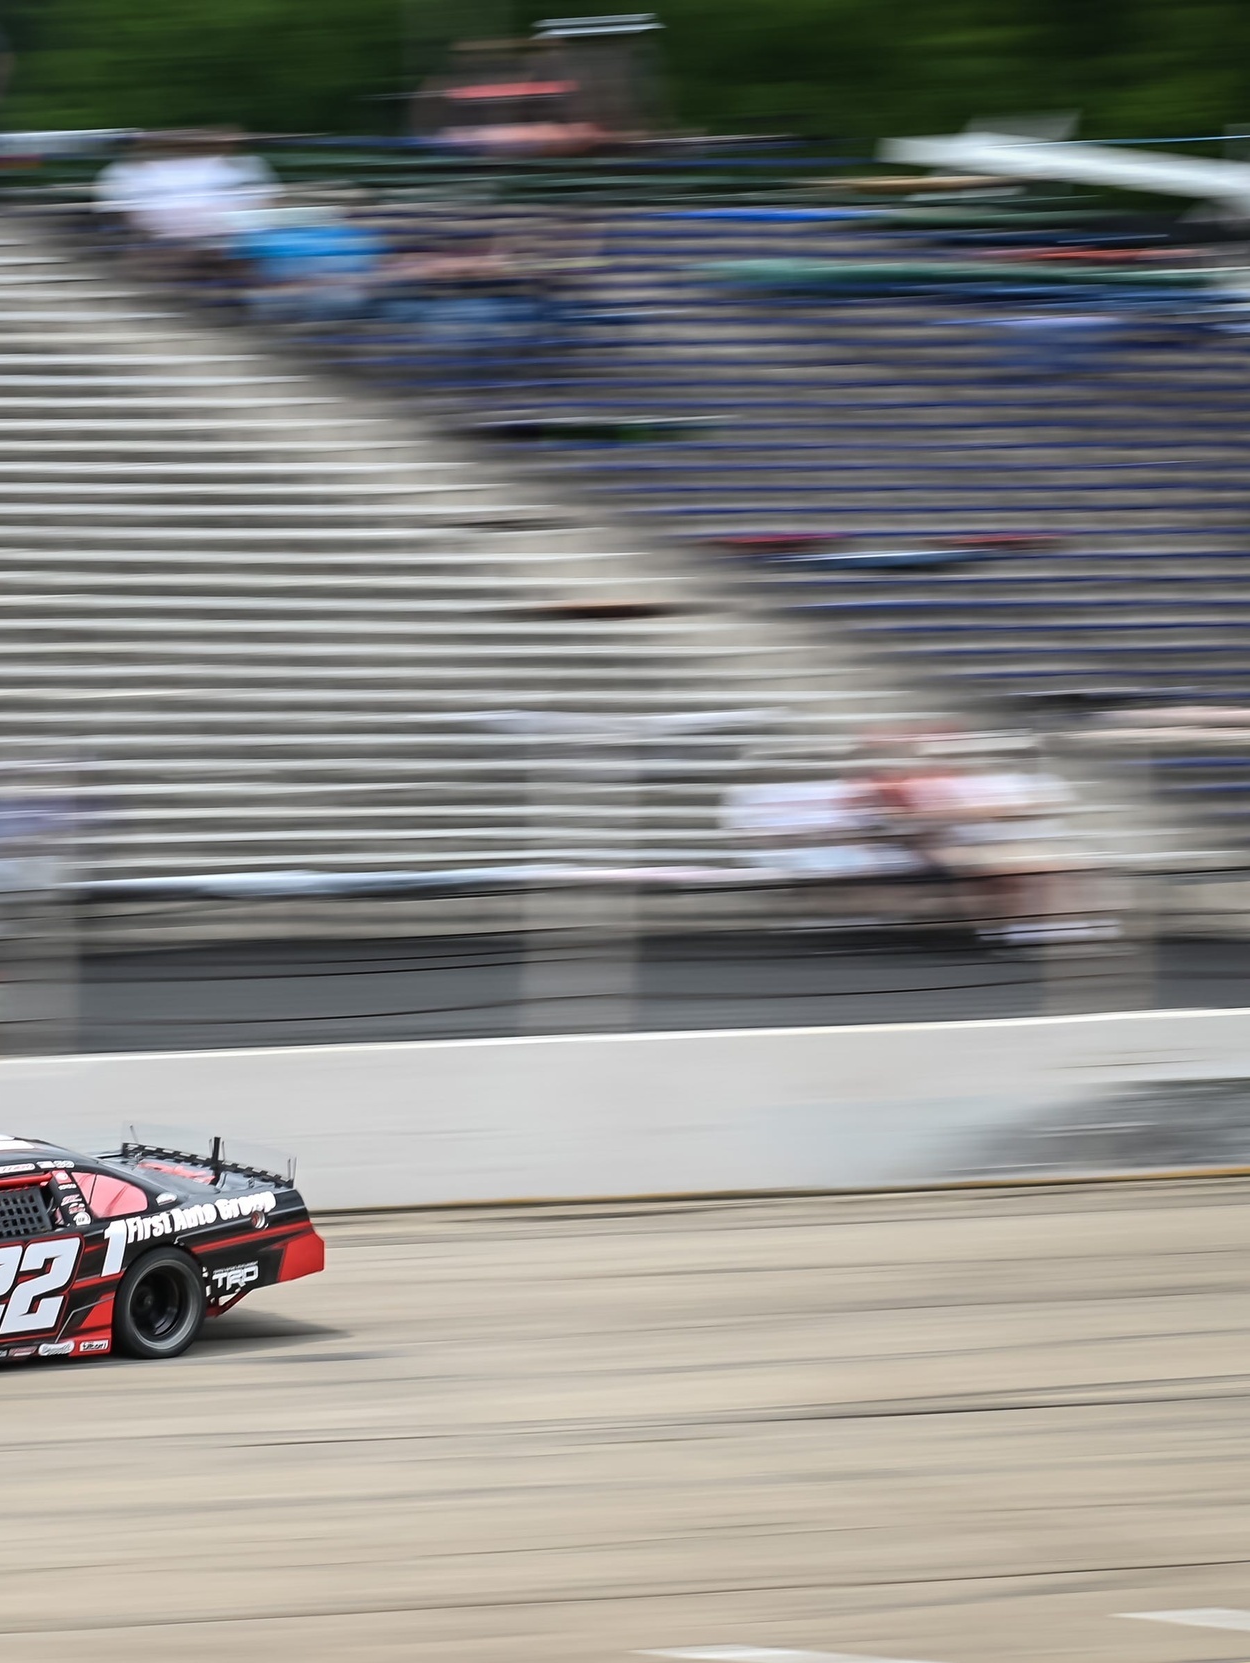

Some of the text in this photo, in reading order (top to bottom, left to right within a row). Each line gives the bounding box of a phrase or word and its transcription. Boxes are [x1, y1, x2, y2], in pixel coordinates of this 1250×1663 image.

[127, 1210, 173, 1244] First
[173, 1203, 217, 1232] Auto
[212, 1265, 258, 1290] TRD
